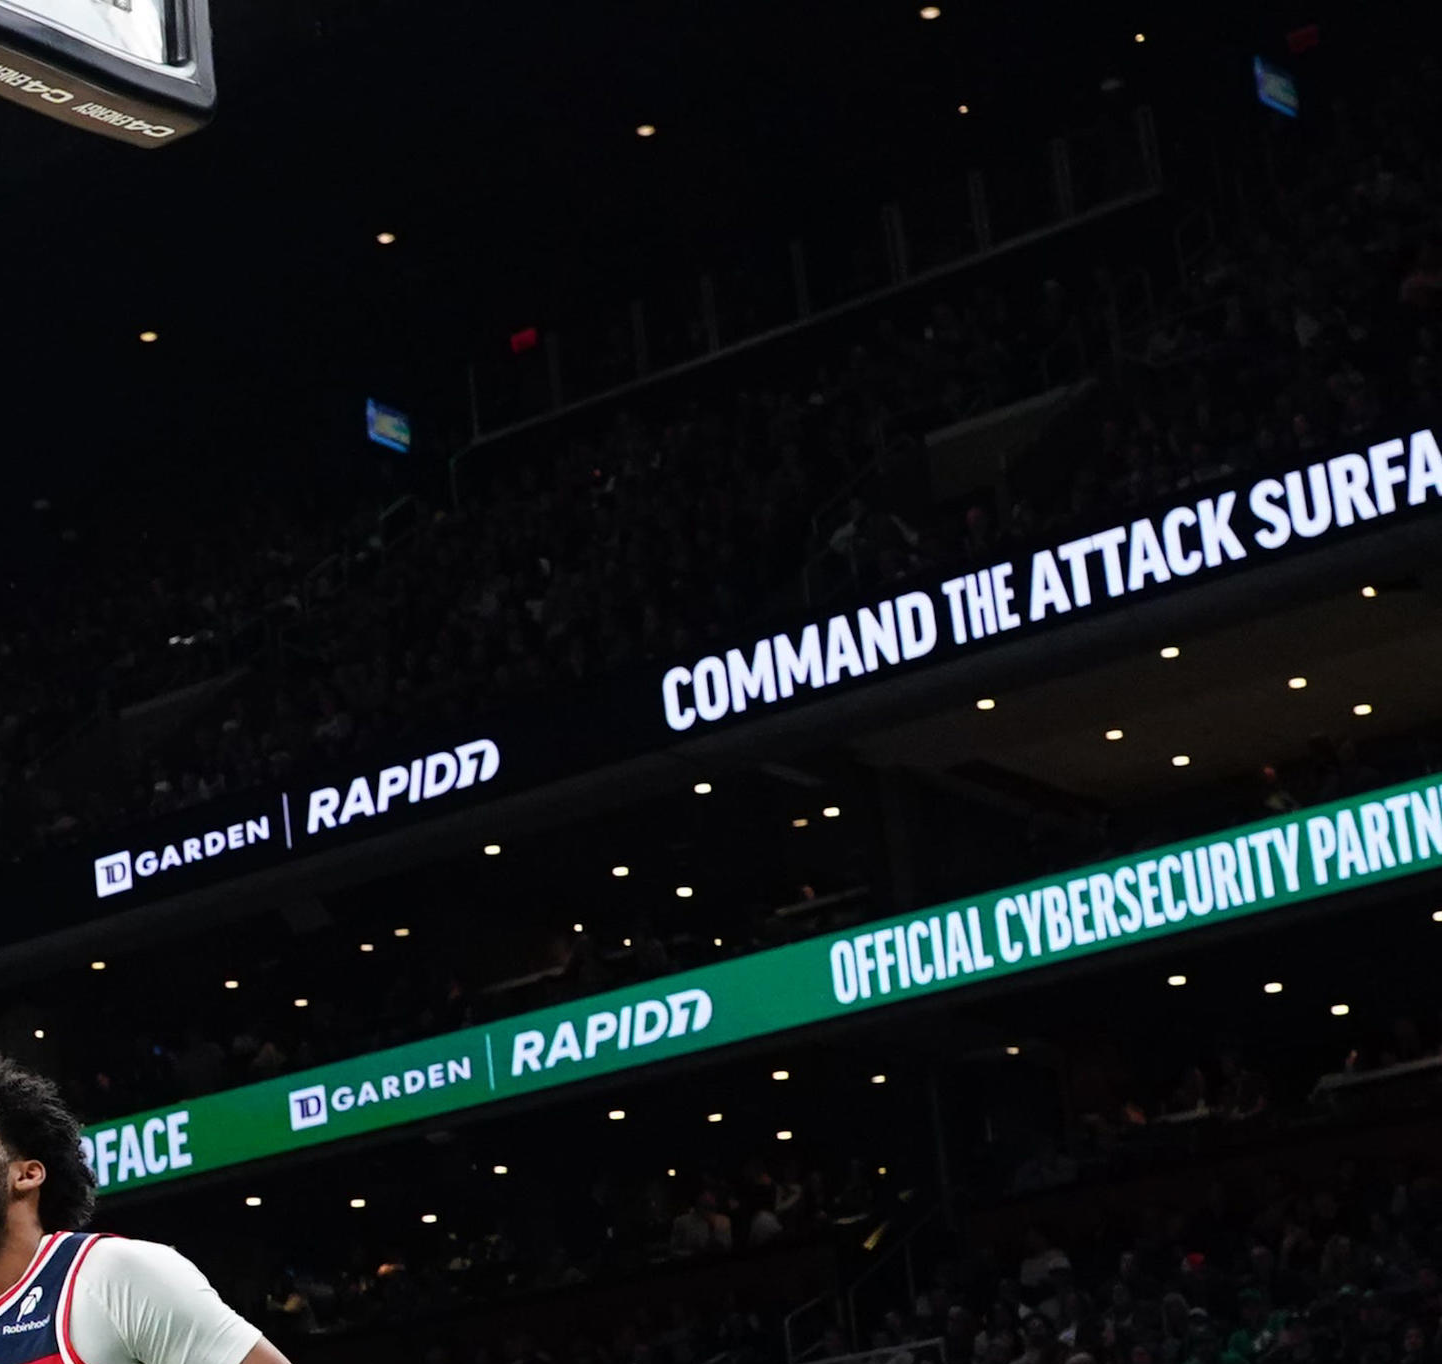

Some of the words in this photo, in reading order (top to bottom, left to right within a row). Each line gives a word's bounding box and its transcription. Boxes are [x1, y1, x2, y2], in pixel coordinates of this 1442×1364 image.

[71, 102, 135, 127] ENERGY
[662, 591, 938, 731] COMMAND
[942, 562, 1021, 645] THE
[1029, 491, 1247, 622] ATTACK
[135, 815, 270, 877] GARDEN
[830, 906, 994, 1005] OFFICIAL
[995, 822, 1302, 963] CYBERSECURITY
[331, 1056, 472, 1112] GARDEN
